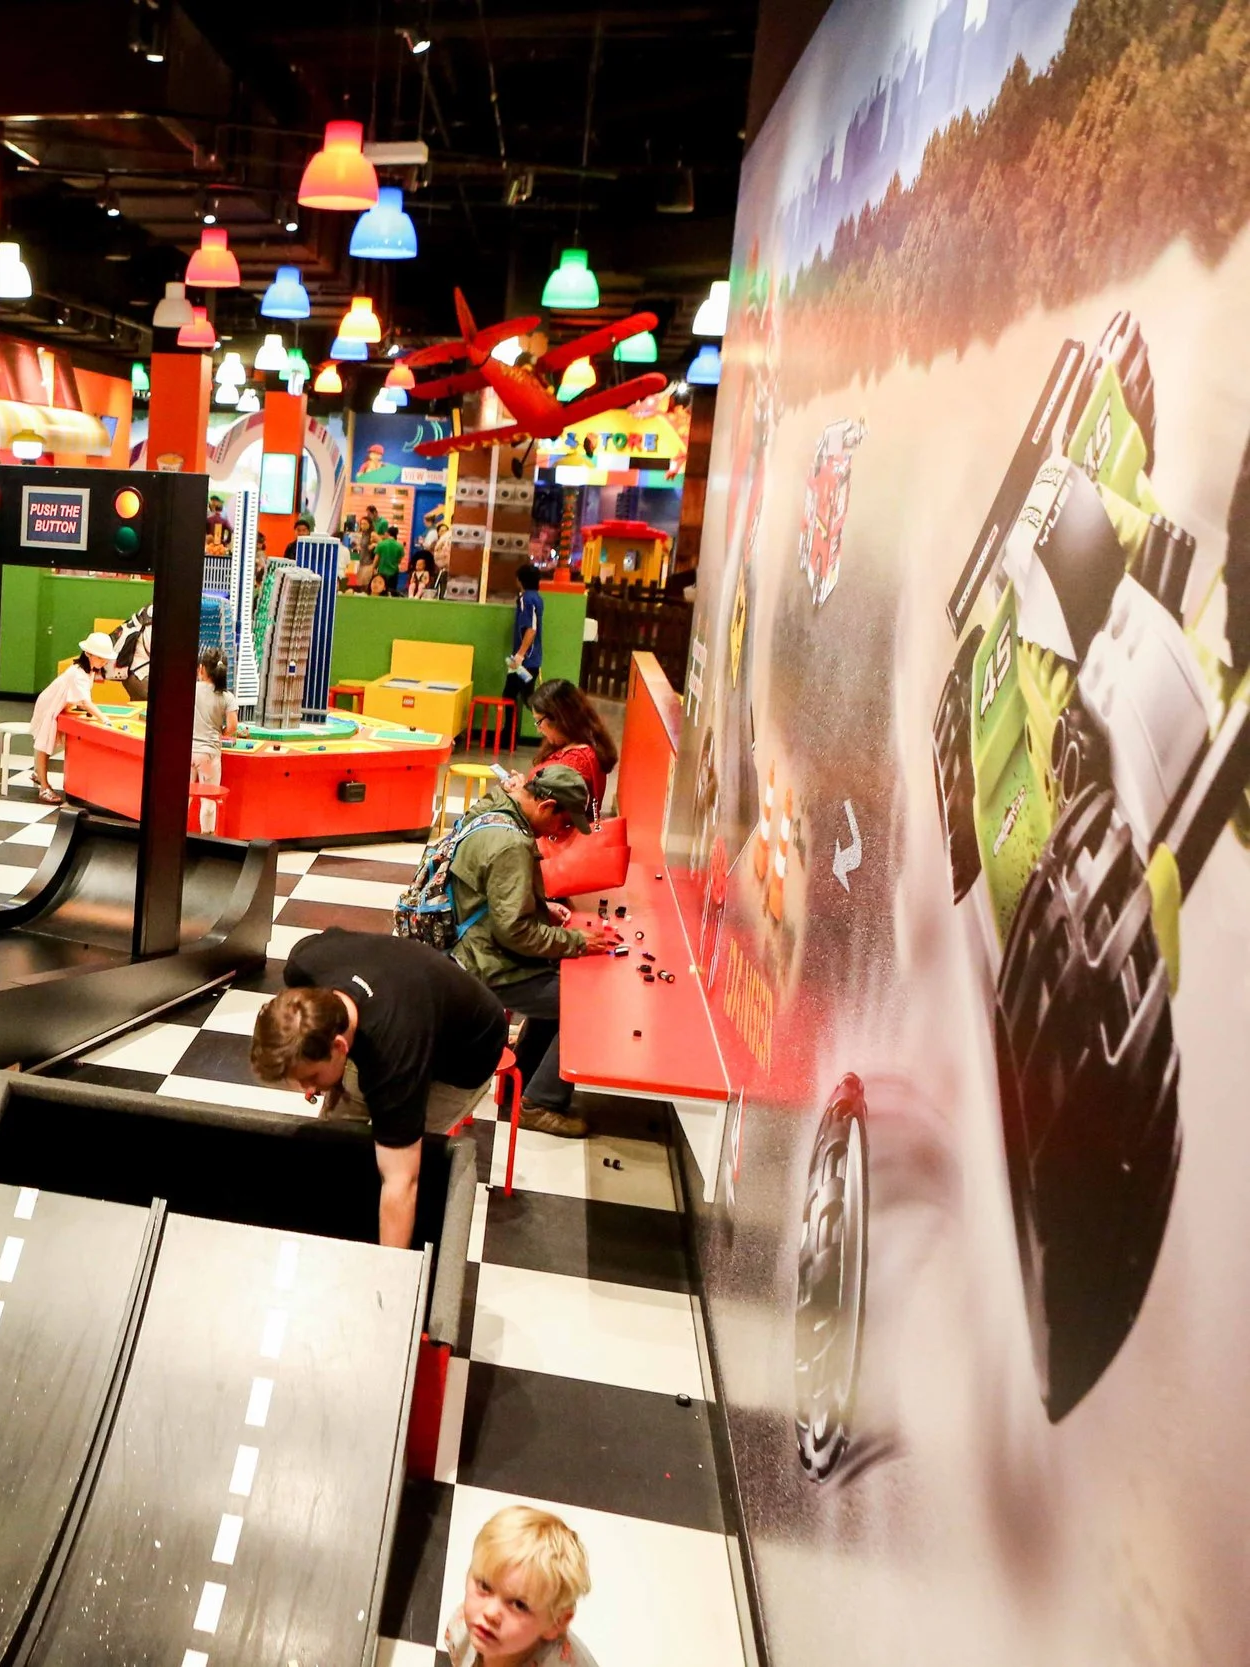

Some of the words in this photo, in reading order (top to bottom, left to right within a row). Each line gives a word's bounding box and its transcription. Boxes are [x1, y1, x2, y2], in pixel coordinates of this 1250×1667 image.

[30, 503, 58, 516] PUSH
[60, 504, 81, 517] THE
[34, 519, 77, 533] BUTTON
[979, 618, 1011, 718] 45
